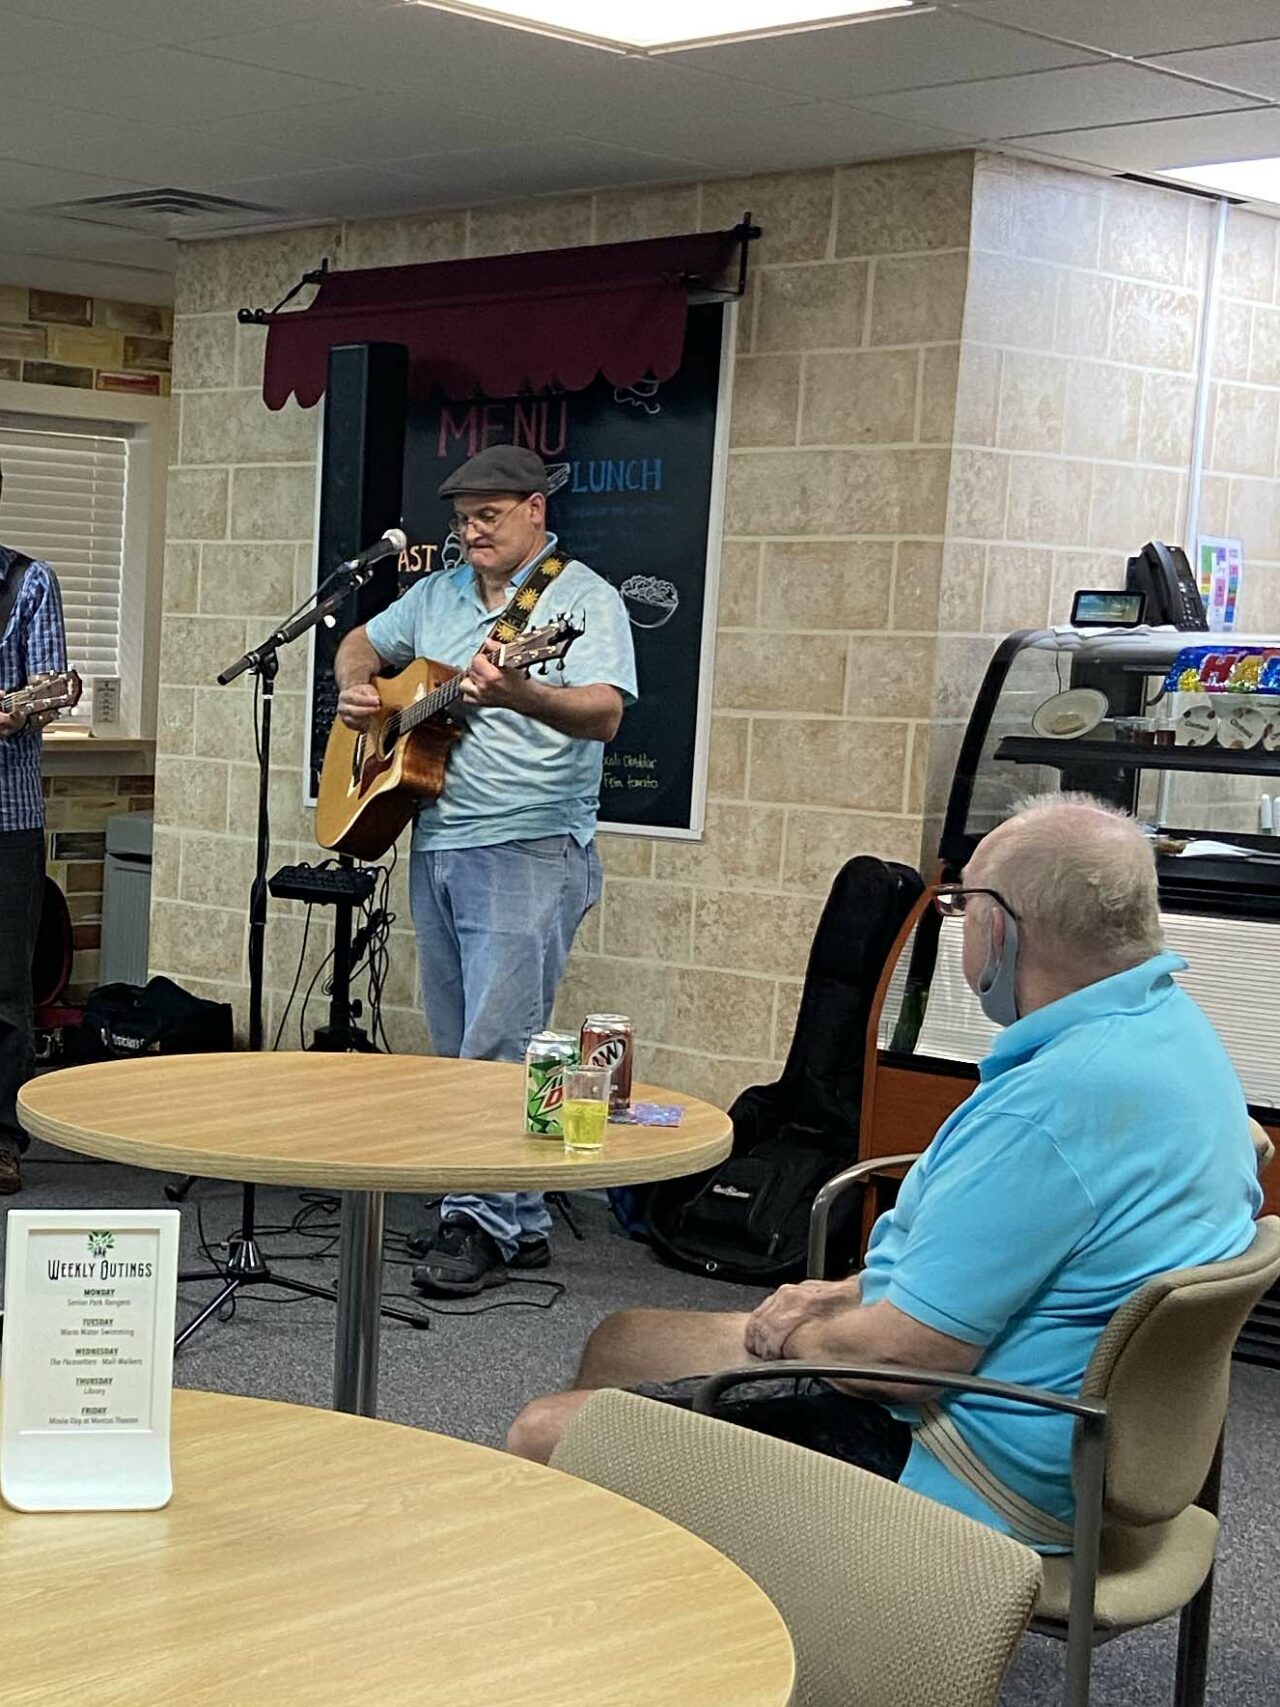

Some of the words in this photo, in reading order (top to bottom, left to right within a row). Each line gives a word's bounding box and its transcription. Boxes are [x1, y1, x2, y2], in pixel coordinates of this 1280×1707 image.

[437, 400, 568, 458] MENU
[571, 458, 662, 493] LUNCH
[48, 1259, 96, 1280] WEEKLY
[100, 1259, 153, 1280] OUTINGS
[82, 1318, 114, 1326] TUESDAY
[75, 1347, 119, 1356] WEDNESDAY
[75, 1377, 113, 1386] THURSDAY
[81, 1407, 107, 1415] FRIDAY
